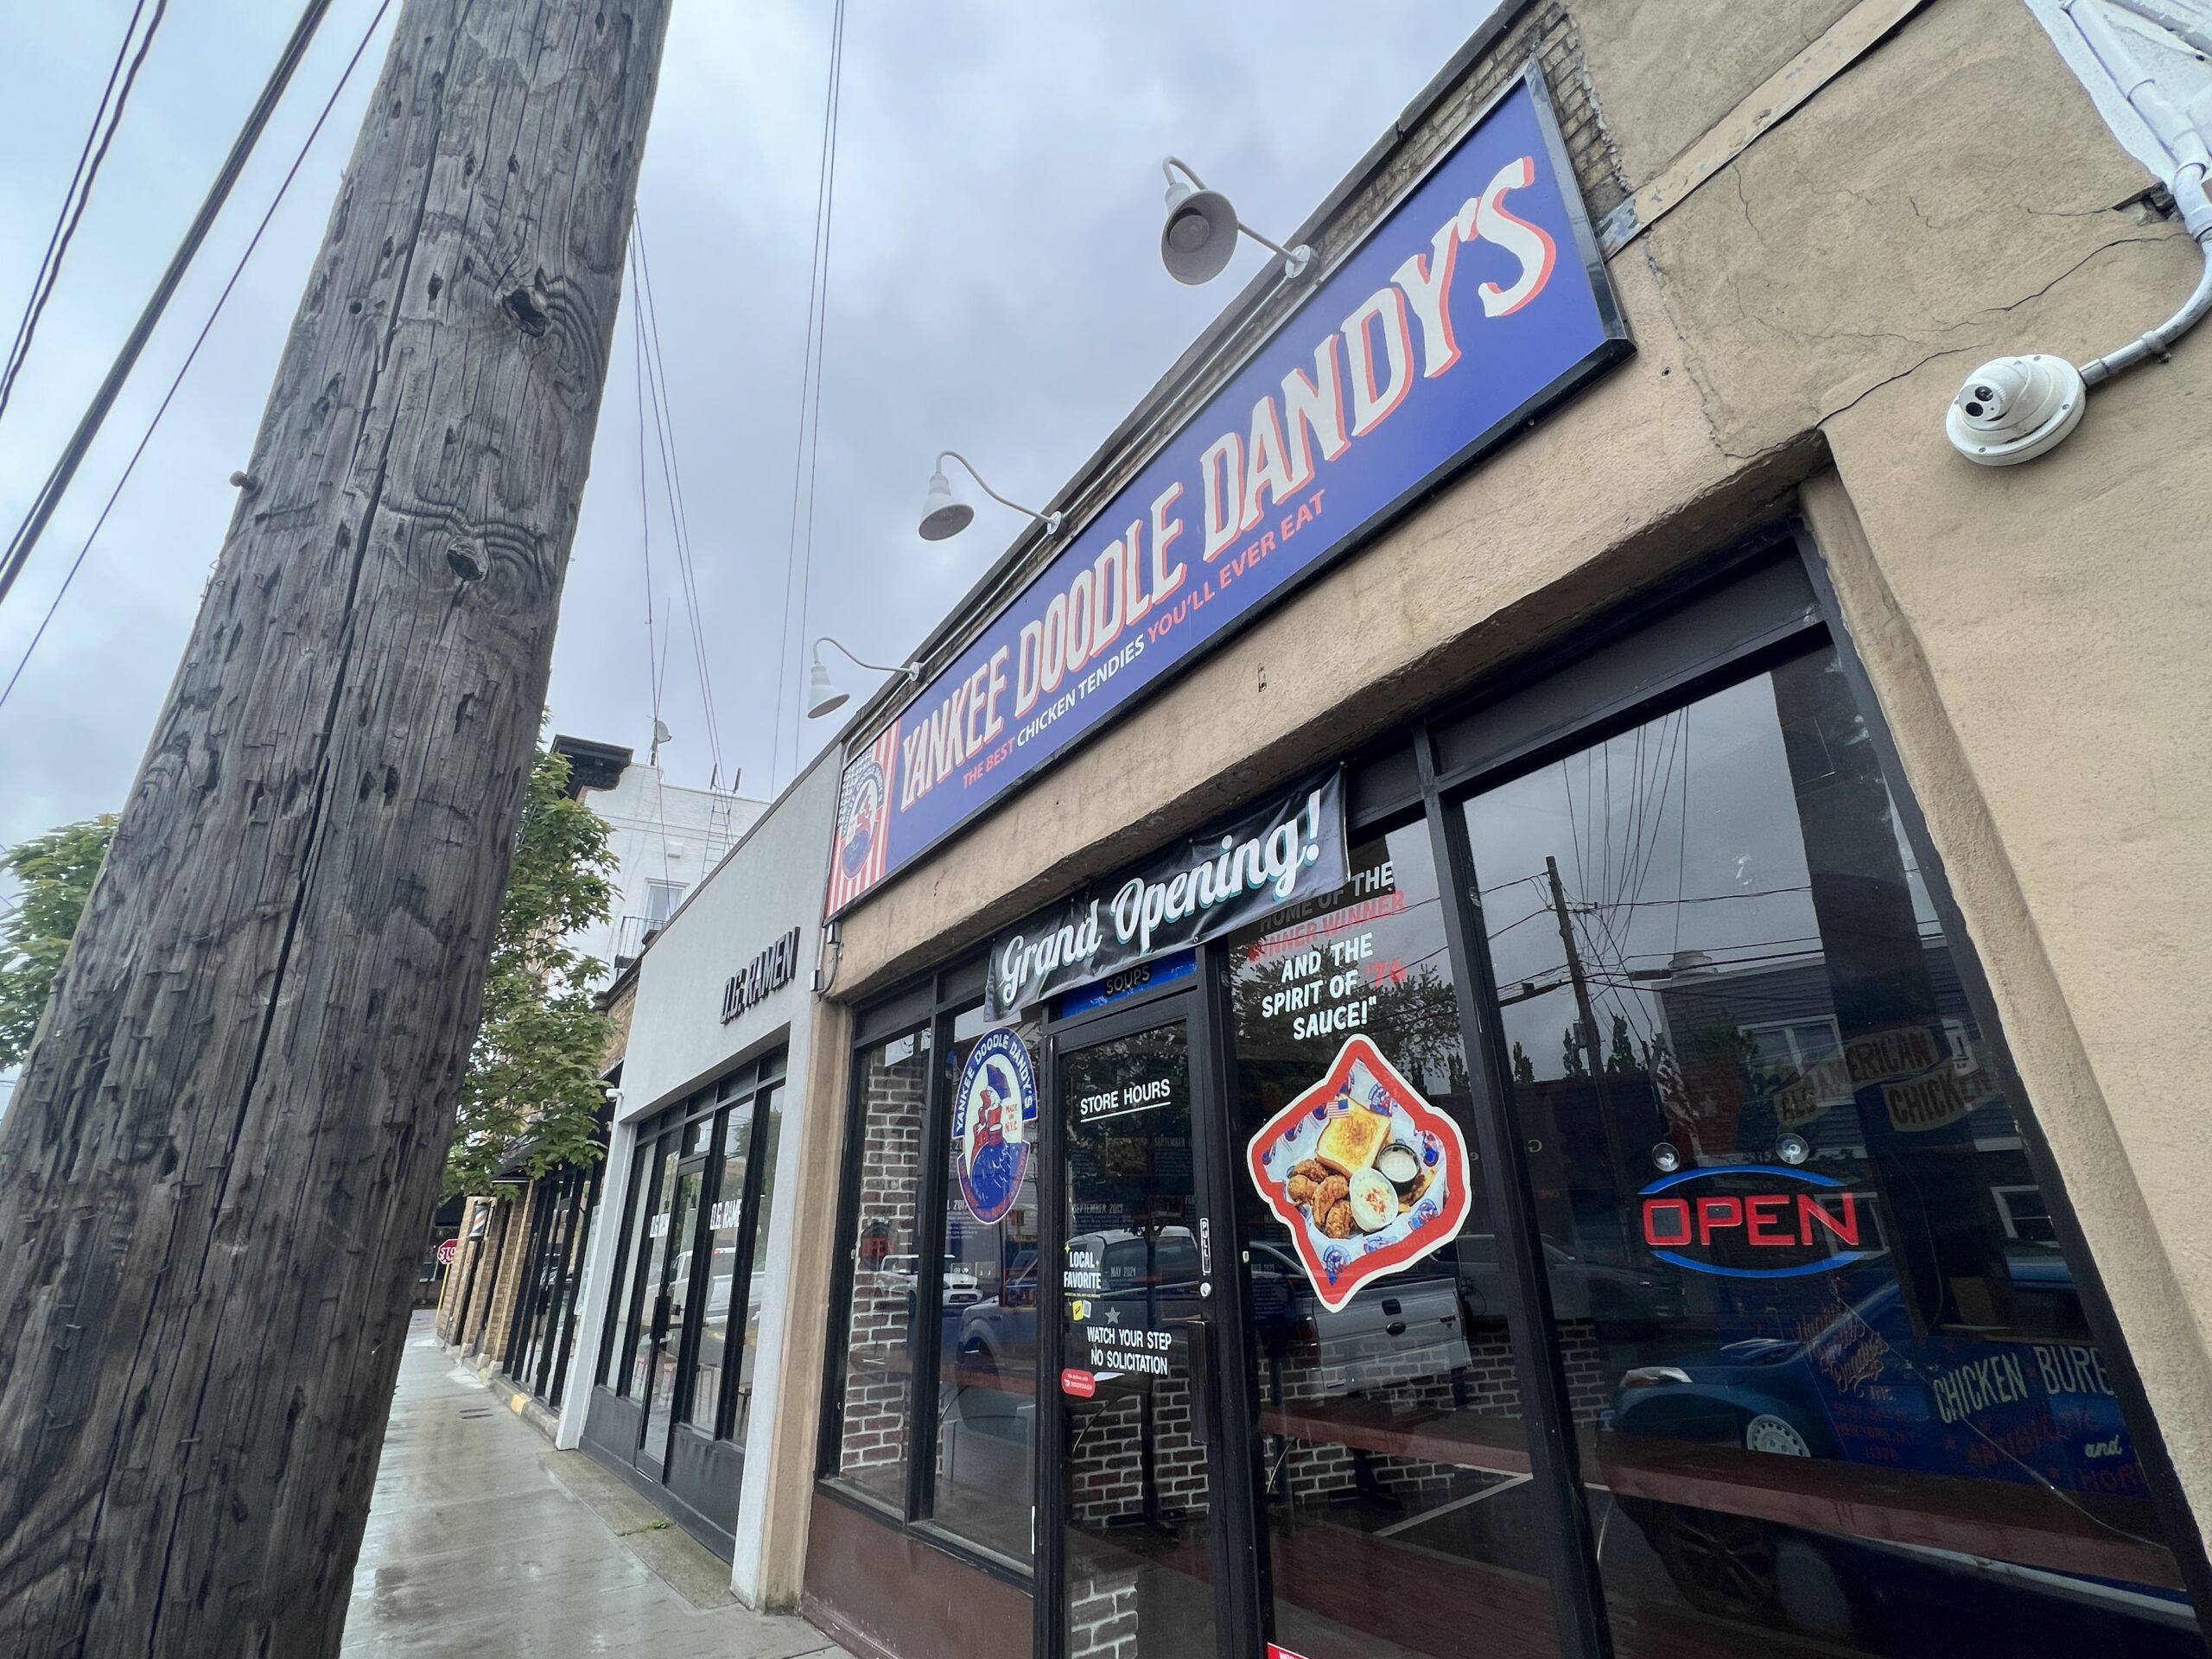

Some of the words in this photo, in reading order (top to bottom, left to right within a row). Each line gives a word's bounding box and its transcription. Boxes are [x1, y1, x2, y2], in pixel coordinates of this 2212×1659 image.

[899, 645, 1009, 812] YANKEE
[1014, 481, 1187, 718] DOODLE
[1199, 156, 1556, 563] DANDY'S
[963, 766, 983, 790] THE
[985, 737, 1017, 773] BEST
[1016, 687, 1077, 748] CHICKEN
[1078, 634, 1146, 700] TENDIES
[1147, 588, 1216, 645] YOU'LL
[1219, 534, 1277, 588] EVER
[1281, 489, 1326, 541] EAT
[1001, 899, 1103, 1005] Grand
[1109, 787, 1321, 957] Opening!
[1351, 861, 1394, 896] THE
[1322, 890, 1406, 937] WINNER
[742, 926, 801, 1007] RAMEN
[1281, 950, 1322, 983] AND
[1331, 932, 1373, 967] THE
[1105, 965, 1151, 995] SOUPS
[1262, 979, 1323, 1018] SPIRIT
[1329, 969, 1358, 999] OF
[956, 1066, 975, 1133] YANKEE
[974, 1033, 1009, 1062] DOODLE
[1008, 1039, 1033, 1109] DANDY'S
[1080, 1090, 1119, 1116] STORE
[1123, 1078, 1171, 1105] HOURS
[722, 1199, 742, 1229] RAME
[1643, 1192, 1860, 1246] OPEN
[440, 1247, 456, 1256] STO
[1069, 1251, 1095, 1268] LOCAL
[1064, 1271, 1102, 1289] FAVORITE
[1087, 1325, 1116, 1344] WATCH
[1119, 1328, 1144, 1348] YOUR
[1147, 1332, 1172, 1351] STEP
[1090, 1349, 1103, 1366] NO
[1107, 1350, 1167, 1376] SOLICITATION
[1932, 1351, 2028, 1424] CHICKEN
[2084, 1433, 2123, 1459] and
